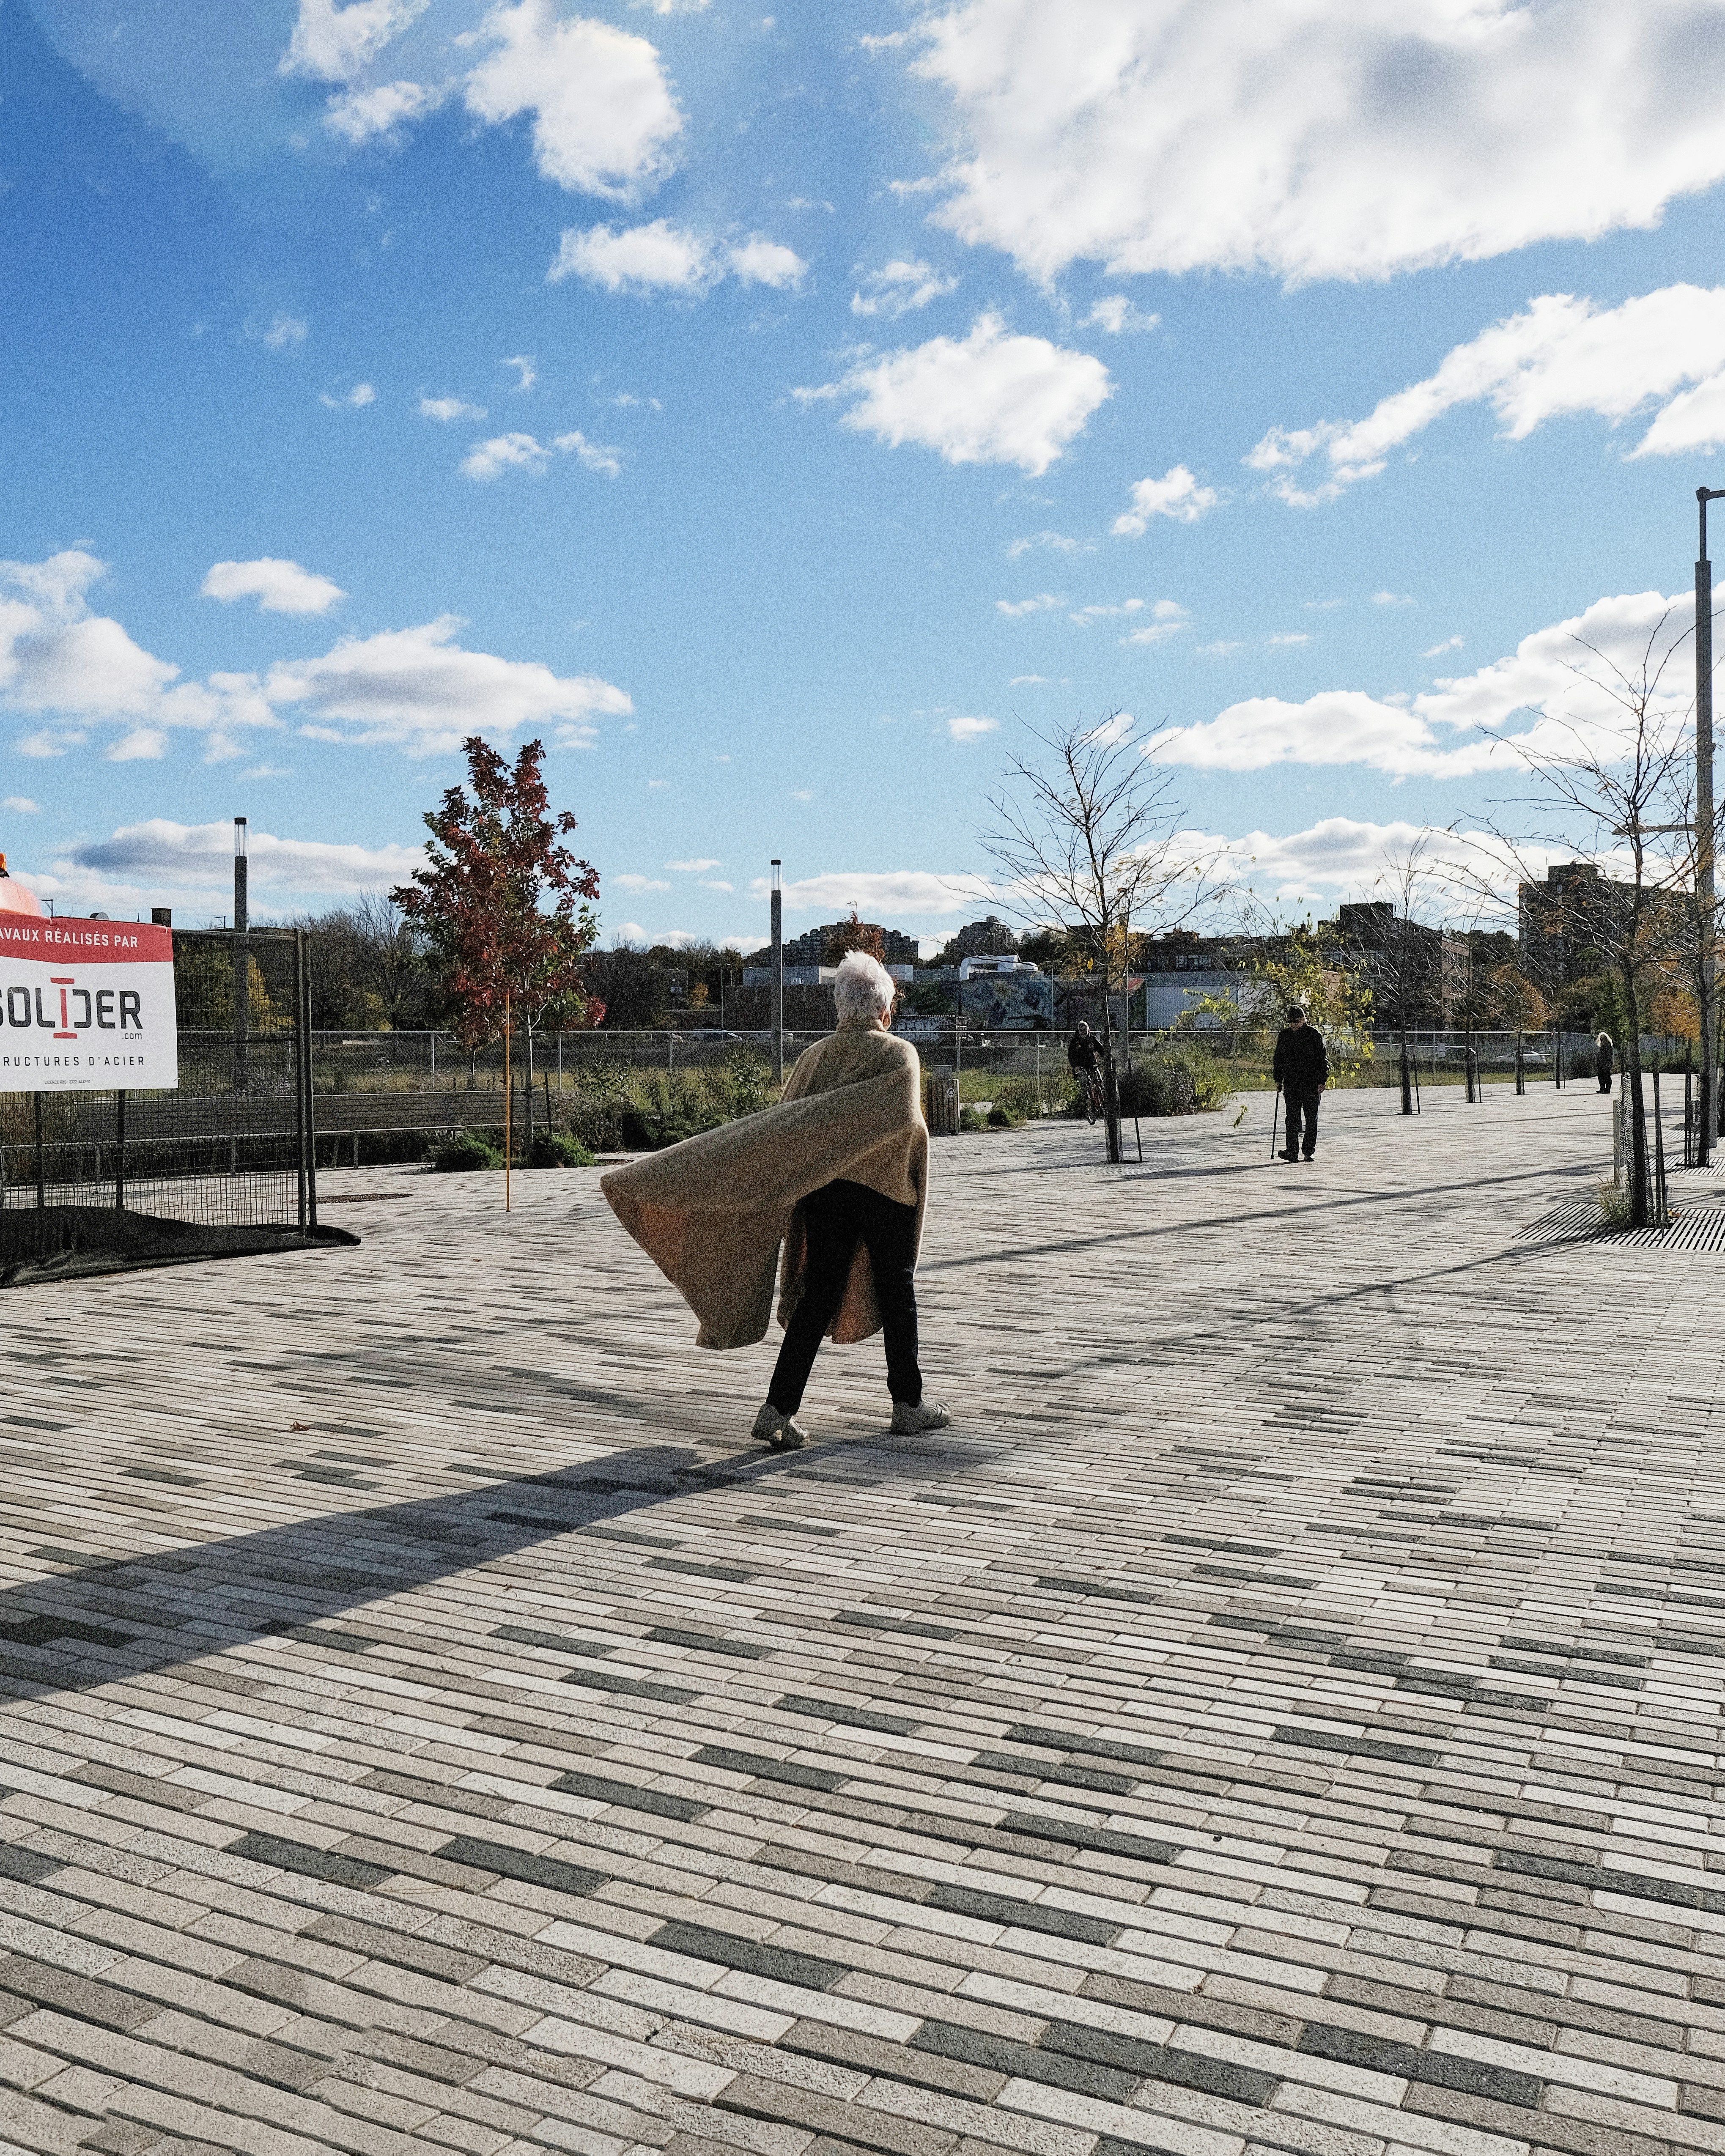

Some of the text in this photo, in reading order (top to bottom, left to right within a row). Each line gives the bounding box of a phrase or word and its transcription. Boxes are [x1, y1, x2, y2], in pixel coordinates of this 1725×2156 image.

[45, 928, 109, 946] RÉALISÉS
[114, 935, 138, 948] PAR
[0, 977, 143, 1039] OLIDER
[3, 1056, 144, 1066] RUCTURES D'ACIER
